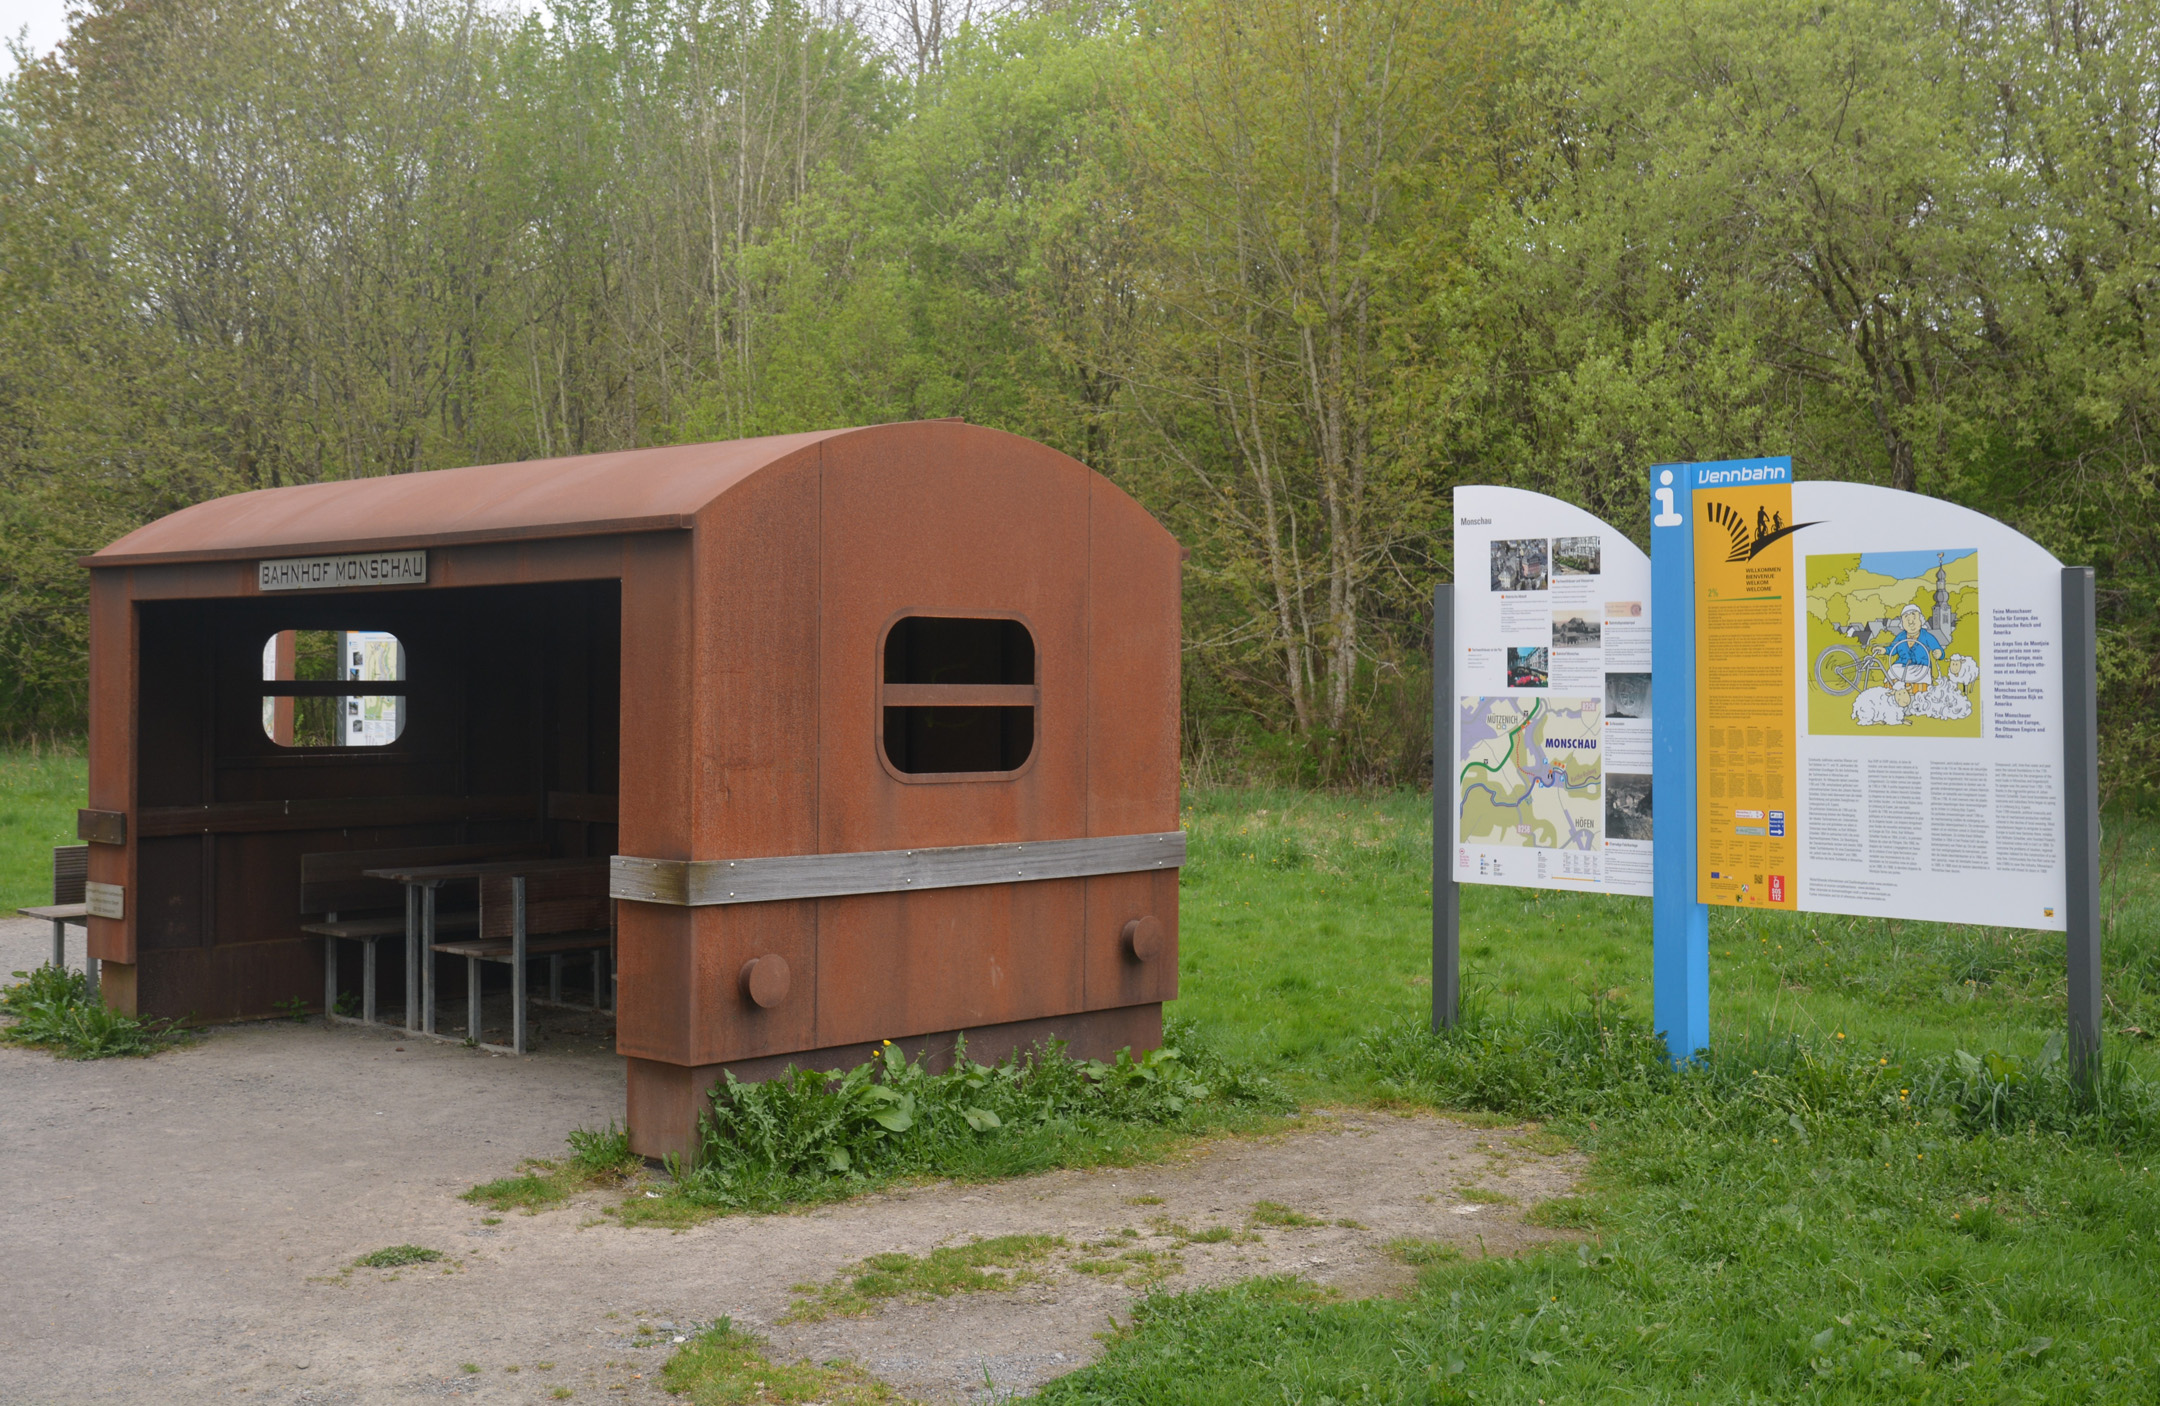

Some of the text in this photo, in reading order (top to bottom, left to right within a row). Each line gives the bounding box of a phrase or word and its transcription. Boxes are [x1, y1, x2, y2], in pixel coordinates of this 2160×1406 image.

[1698, 466, 1785, 484] Vennbahn
[1461, 517, 1492, 526] Monschau
[262, 557, 423, 584] BAHNHOF MONSCHAU
[1708, 588, 1718, 597] 2%
[1487, 714, 1518, 724] MÜTZENICH
[1545, 738, 1597, 749] MONSCHAU
[1575, 817, 1594, 828] HÖFEN
